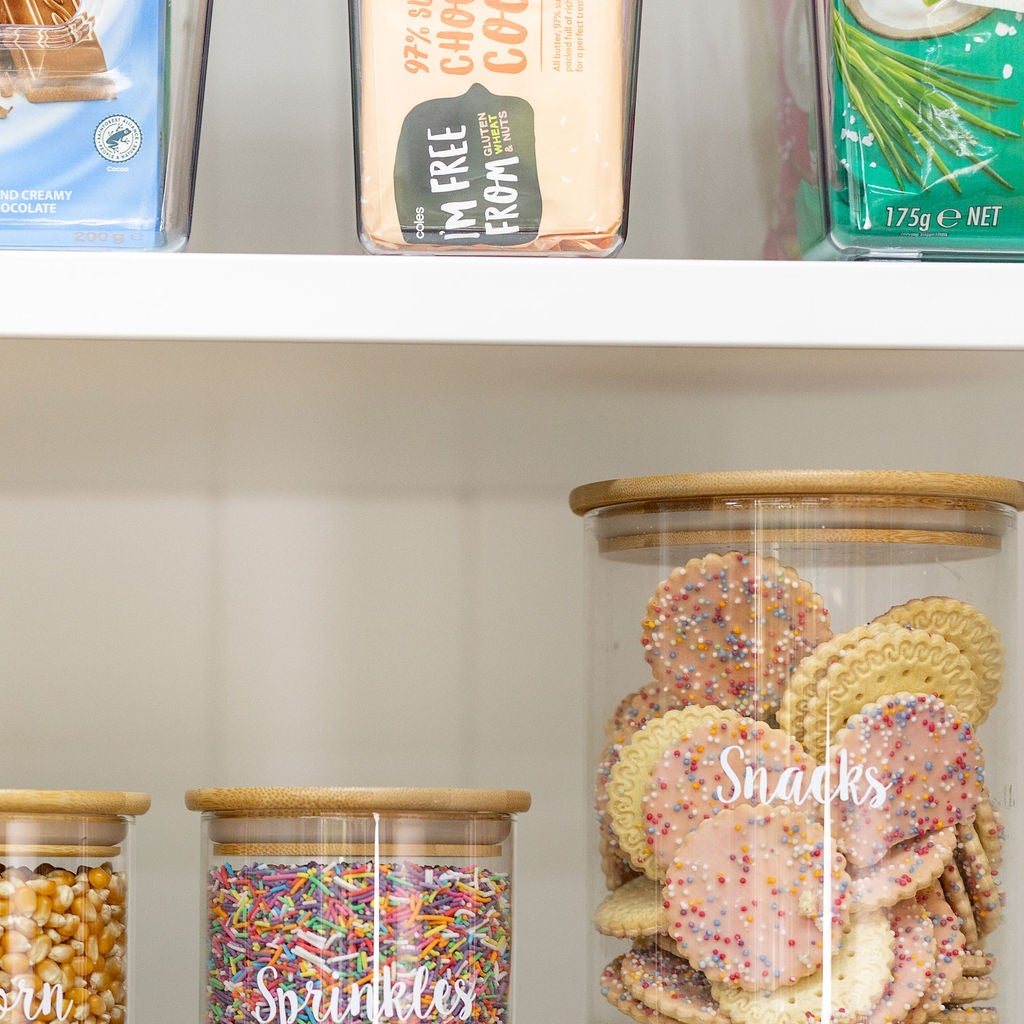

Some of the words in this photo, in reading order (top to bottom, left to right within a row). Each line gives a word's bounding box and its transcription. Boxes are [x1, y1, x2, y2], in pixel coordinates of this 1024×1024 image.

[436, 0, 475, 75] CHO
[564, 27, 572, 40] full
[576, 20, 585, 51] perfect
[404, 27, 431, 74] 97%
[564, 41, 574, 72] packed
[575, 60, 583, 72] for
[477, 112, 493, 156] GLUTEN
[488, 114, 503, 155] WHEAT
[498, 110, 512, 142] NUTS
[427, 125, 470, 193] FREE
[504, 144, 514, 153] &
[21, 190, 73, 201] CREAMY
[483, 156, 520, 235] FROM
[413, 206, 425, 239] coles
[886, 206, 931, 232] 175g
[966, 206, 1003, 227] NET
[74, 231, 109, 243] 200
[715, 744, 893, 809] Snacks
